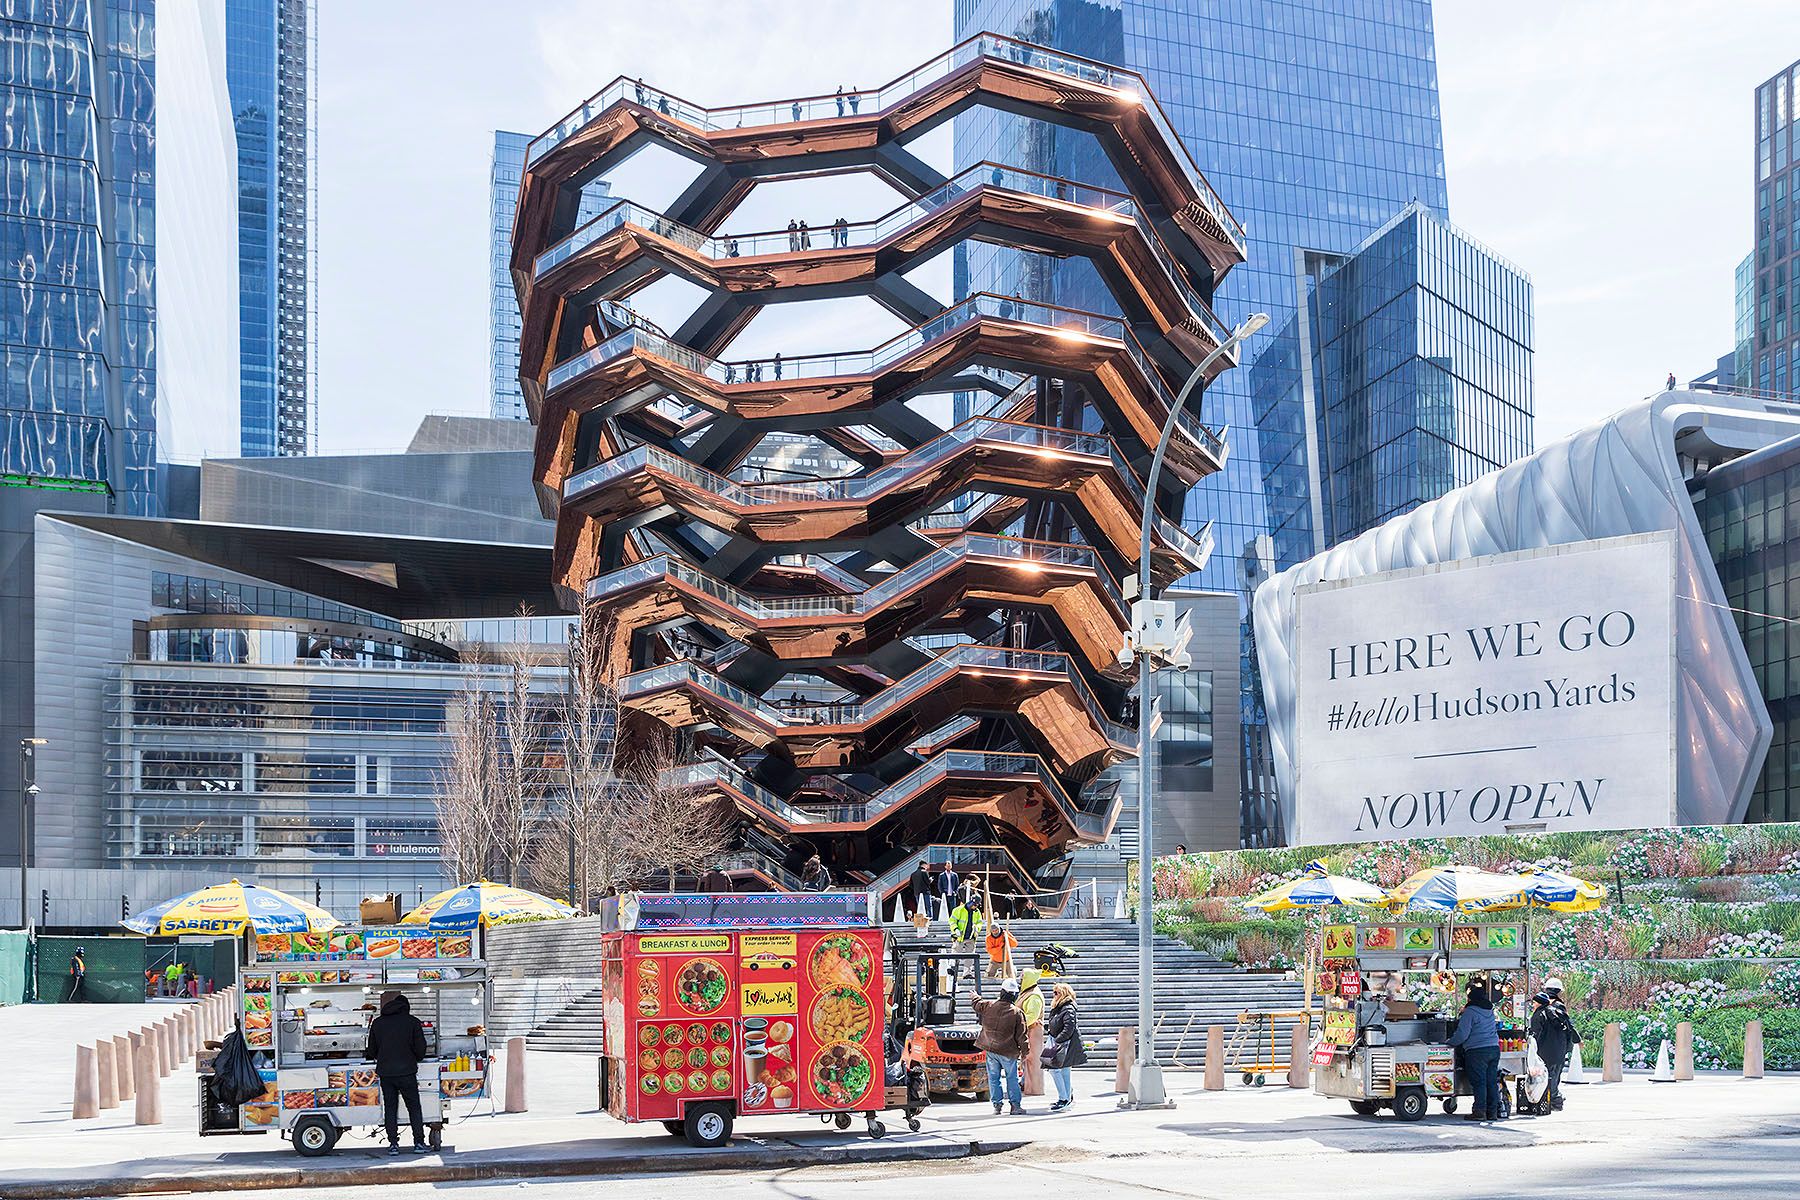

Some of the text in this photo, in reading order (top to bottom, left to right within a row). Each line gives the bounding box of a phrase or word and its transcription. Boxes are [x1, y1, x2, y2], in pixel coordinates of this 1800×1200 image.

[1328, 610, 1636, 681] HERE WE GO
[1327, 672, 1637, 732] #helloHudsonYards
[1353, 778, 1607, 832] NOW OPEN
[390, 845, 440, 854] lululemon
[164, 919, 243, 931] SABRETT
[641, 939, 728, 949] BREAKFAST & LUNCH
[1317, 1044, 1336, 1053] HALAL
[1315, 1054, 1331, 1063] FOOD
